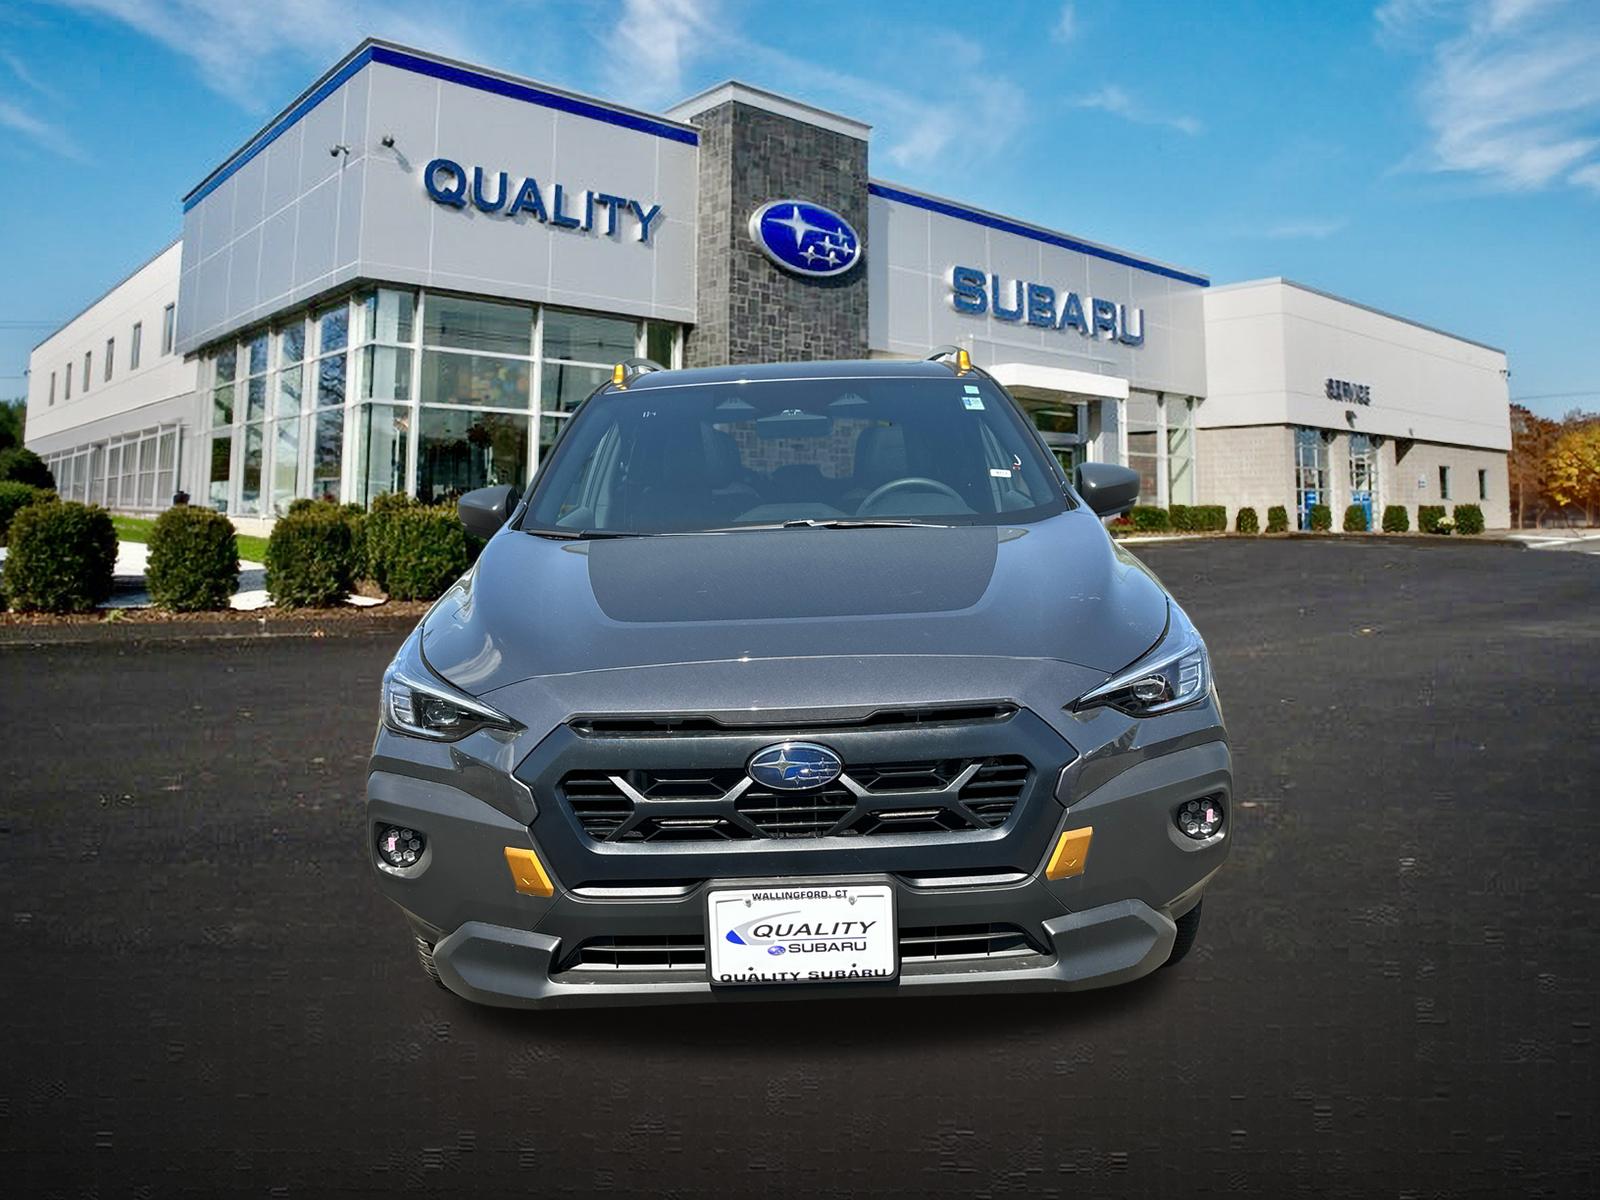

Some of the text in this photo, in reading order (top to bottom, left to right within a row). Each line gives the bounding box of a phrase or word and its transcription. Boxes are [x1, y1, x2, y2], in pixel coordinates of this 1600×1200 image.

[424, 157, 661, 243] QUALITY
[951, 265, 1145, 347] SUBARU
[1325, 377, 1371, 406] SERVICE
[752, 889, 848, 901] WALLINGFORD, CT
[753, 921, 877, 938] QUALITY
[788, 941, 867, 953] SUBARU
[720, 968, 887, 983] QUALITY SUBARU
